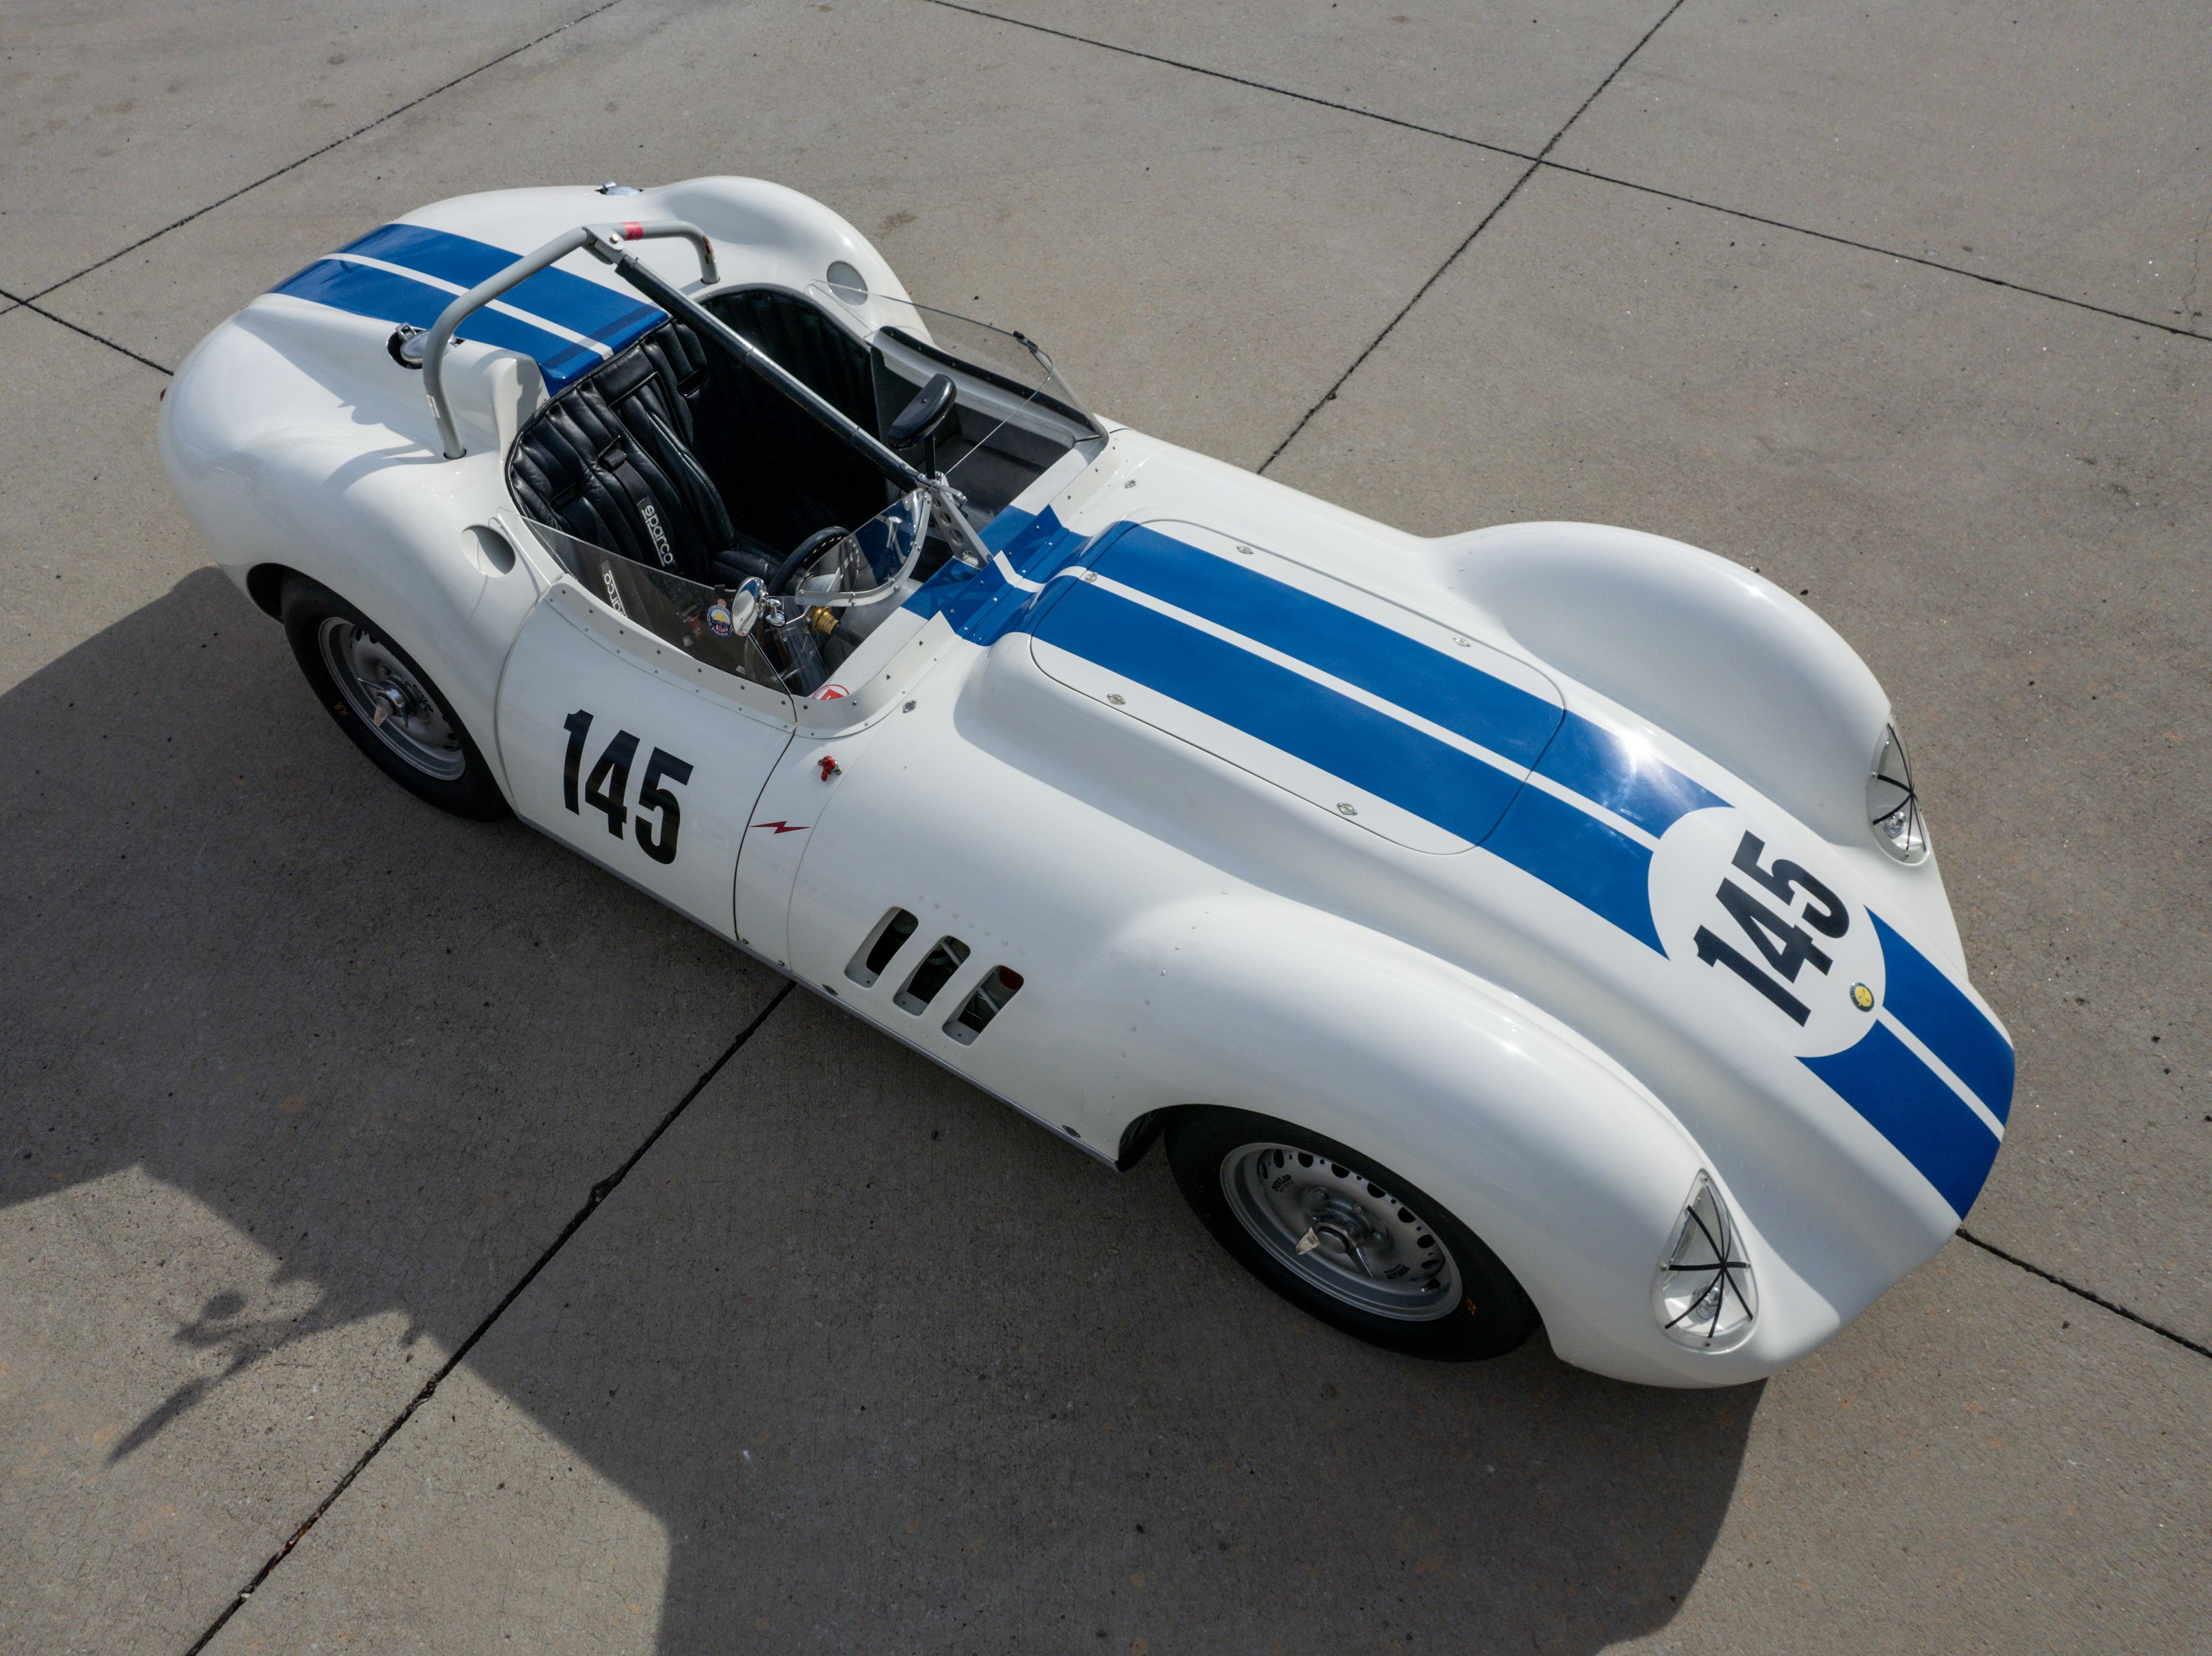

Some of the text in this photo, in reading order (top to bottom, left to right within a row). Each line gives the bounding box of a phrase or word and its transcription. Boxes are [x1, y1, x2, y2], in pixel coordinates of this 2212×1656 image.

[642, 505, 673, 566] sparco
[603, 570, 628, 618] arco
[563, 709, 694, 864] 145
[1693, 830, 1849, 1027] 145
[1272, 1174, 1292, 1191] DUNLOP
